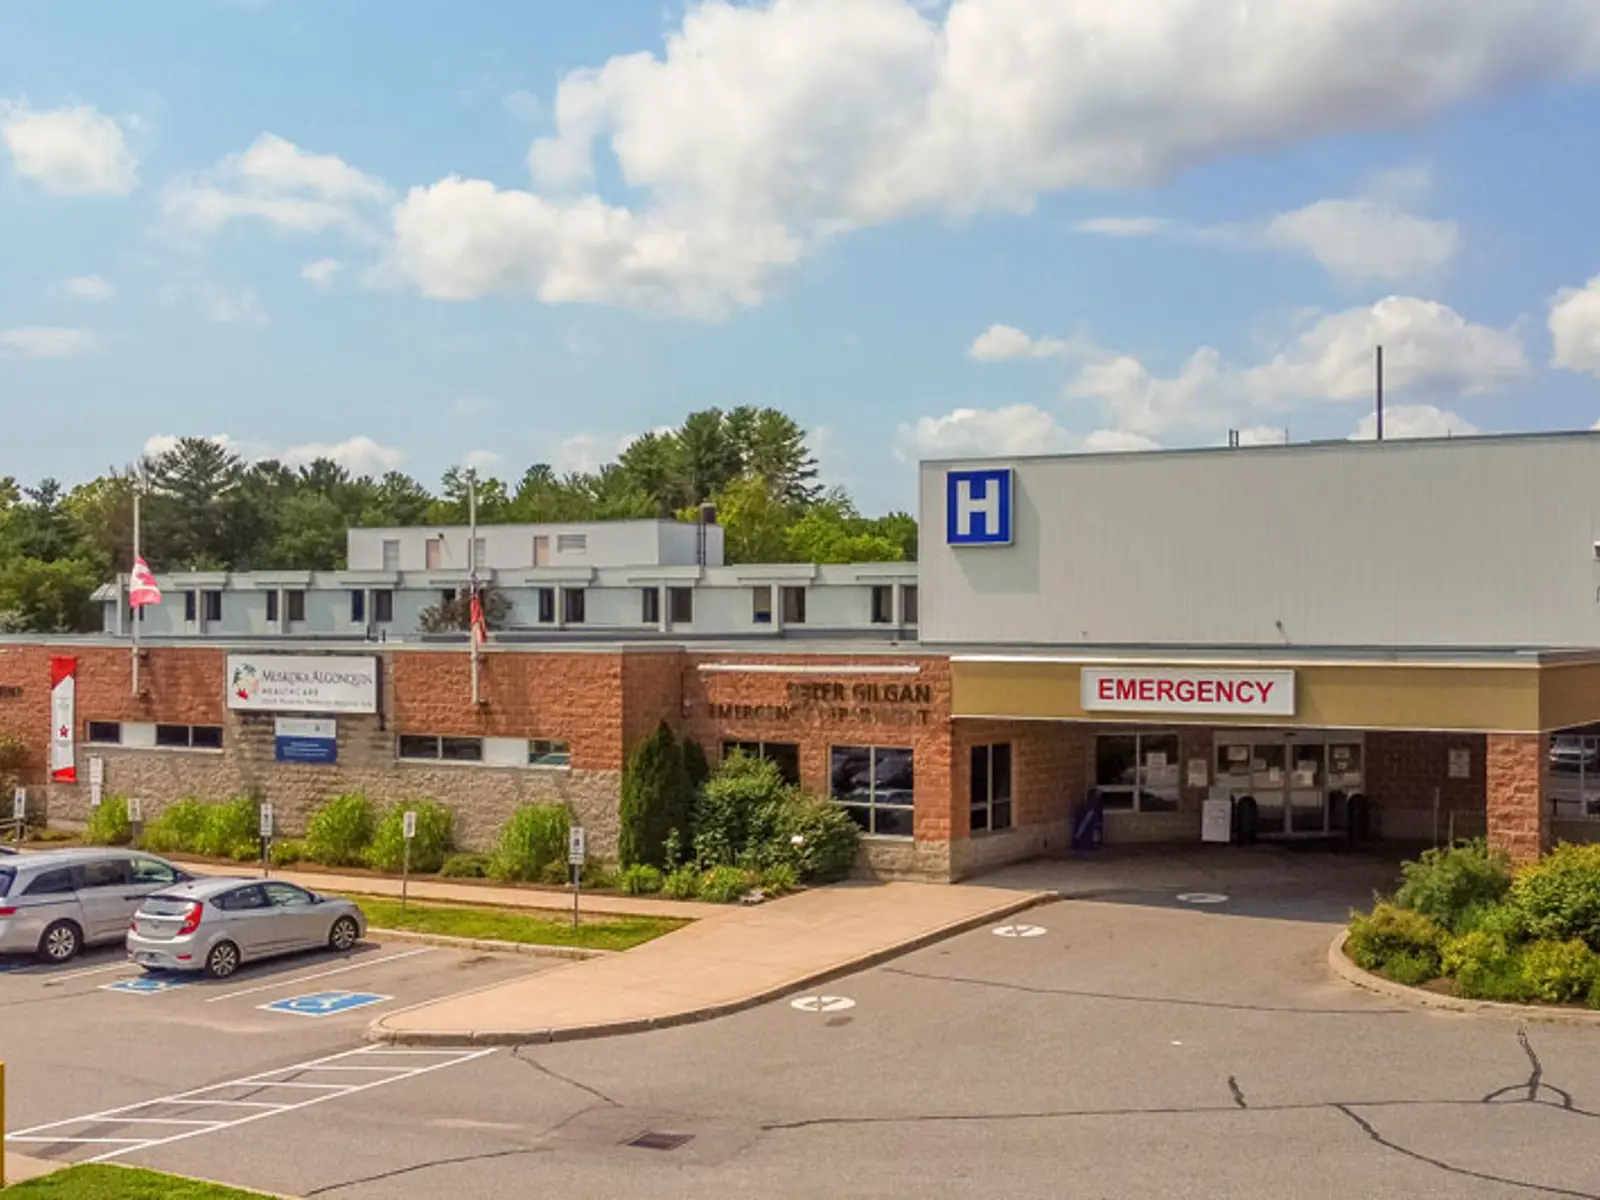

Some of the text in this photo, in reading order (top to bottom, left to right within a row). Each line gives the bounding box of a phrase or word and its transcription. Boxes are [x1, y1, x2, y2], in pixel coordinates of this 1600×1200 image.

[957, 479, 1000, 535] H
[852, 683, 931, 703] GILGAN
[1097, 678, 1275, 703] EMERGENCY
